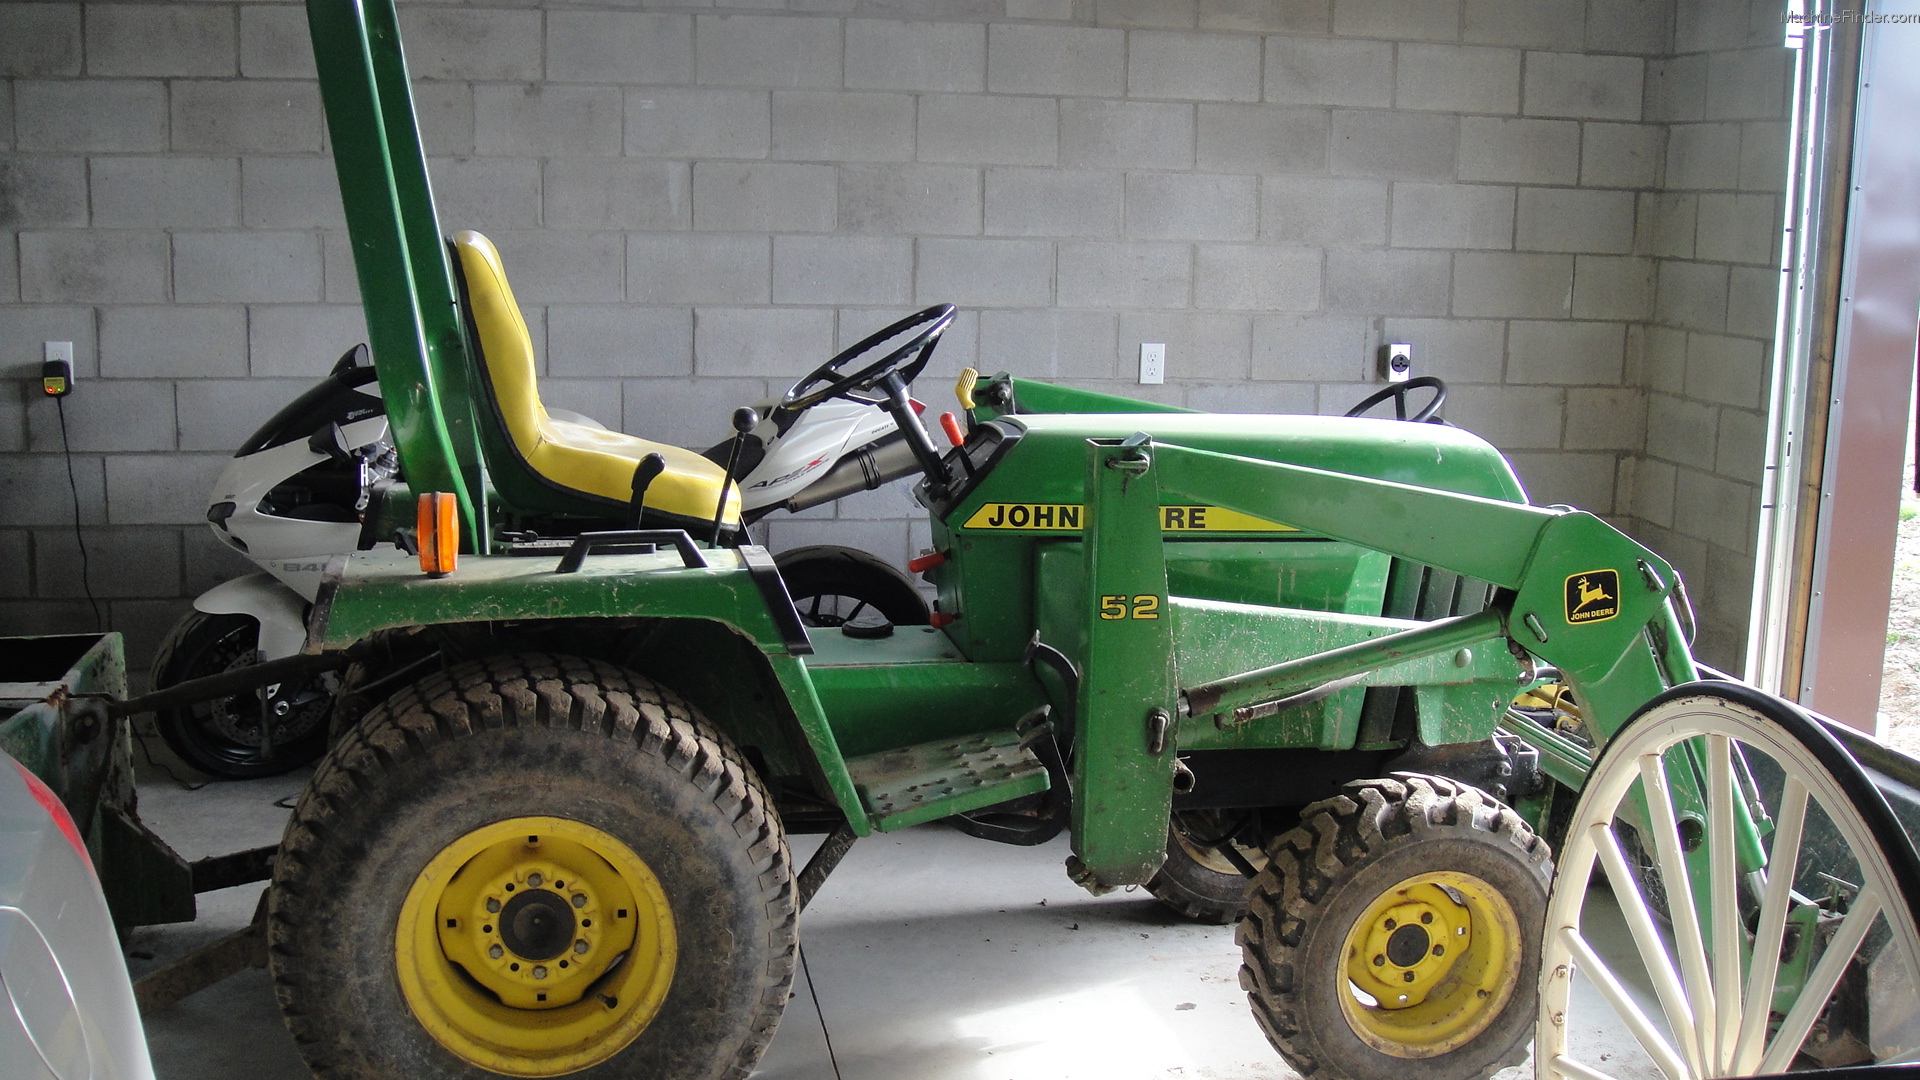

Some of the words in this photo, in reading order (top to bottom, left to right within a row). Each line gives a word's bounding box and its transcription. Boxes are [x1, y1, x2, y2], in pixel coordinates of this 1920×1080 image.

[988, 505, 1079, 528] JOHN
[1100, 594, 1159, 620] 52
[1570, 611, 1590, 621] JOHN
[1591, 607, 1614, 617] DEERE
